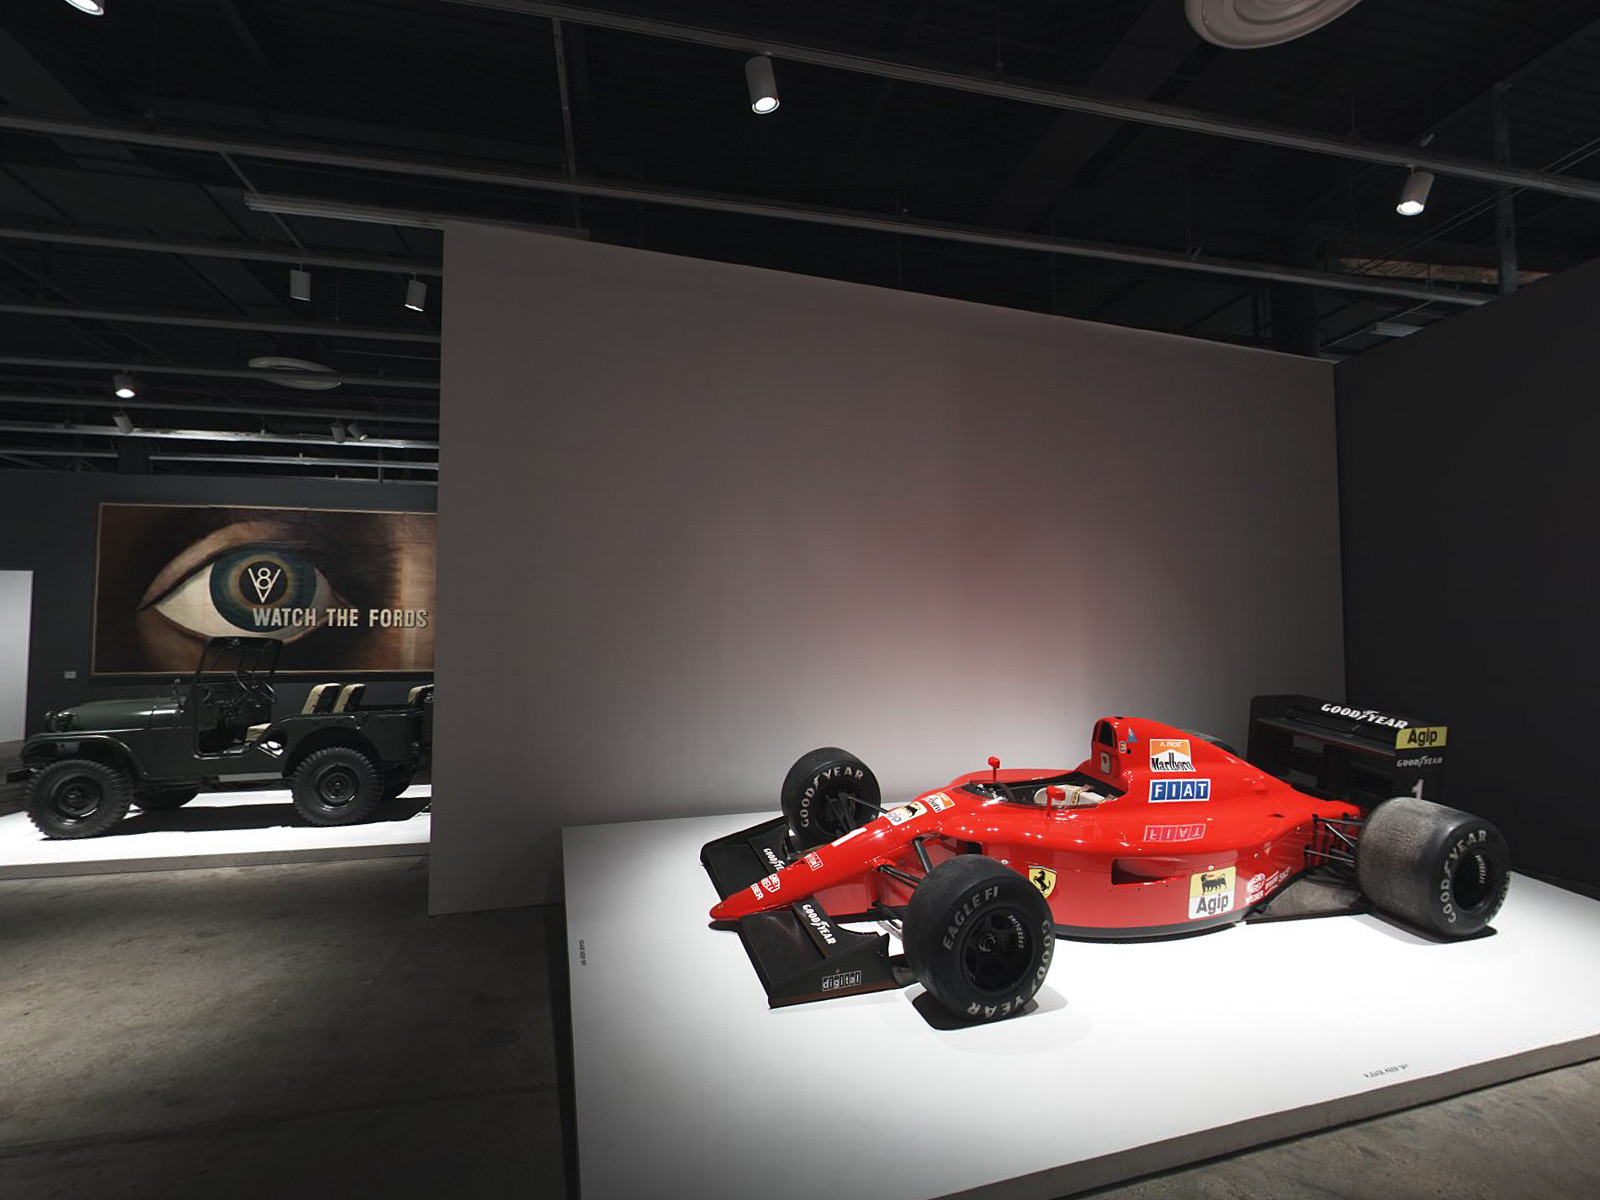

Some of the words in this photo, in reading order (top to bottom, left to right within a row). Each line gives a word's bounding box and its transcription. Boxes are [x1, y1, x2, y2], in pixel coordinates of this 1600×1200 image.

[253, 607, 317, 628] WATCH
[326, 608, 359, 628] THE
[369, 609, 429, 629] FORDS
[1320, 703, 1409, 730] GOODYEAR
[1407, 728, 1438, 747] Agip
[1151, 752, 1194, 770] Marlboro
[1396, 755, 1443, 768] GOODYEAR
[1154, 783, 1206, 798] FIAT
[1411, 778, 1424, 800] 1
[763, 848, 785, 871] GOODYE
[1195, 893, 1229, 915] Agip
[803, 904, 837, 945] GOODYEAR
[942, 893, 981, 950] EAGLE
[822, 971, 861, 990] digital
